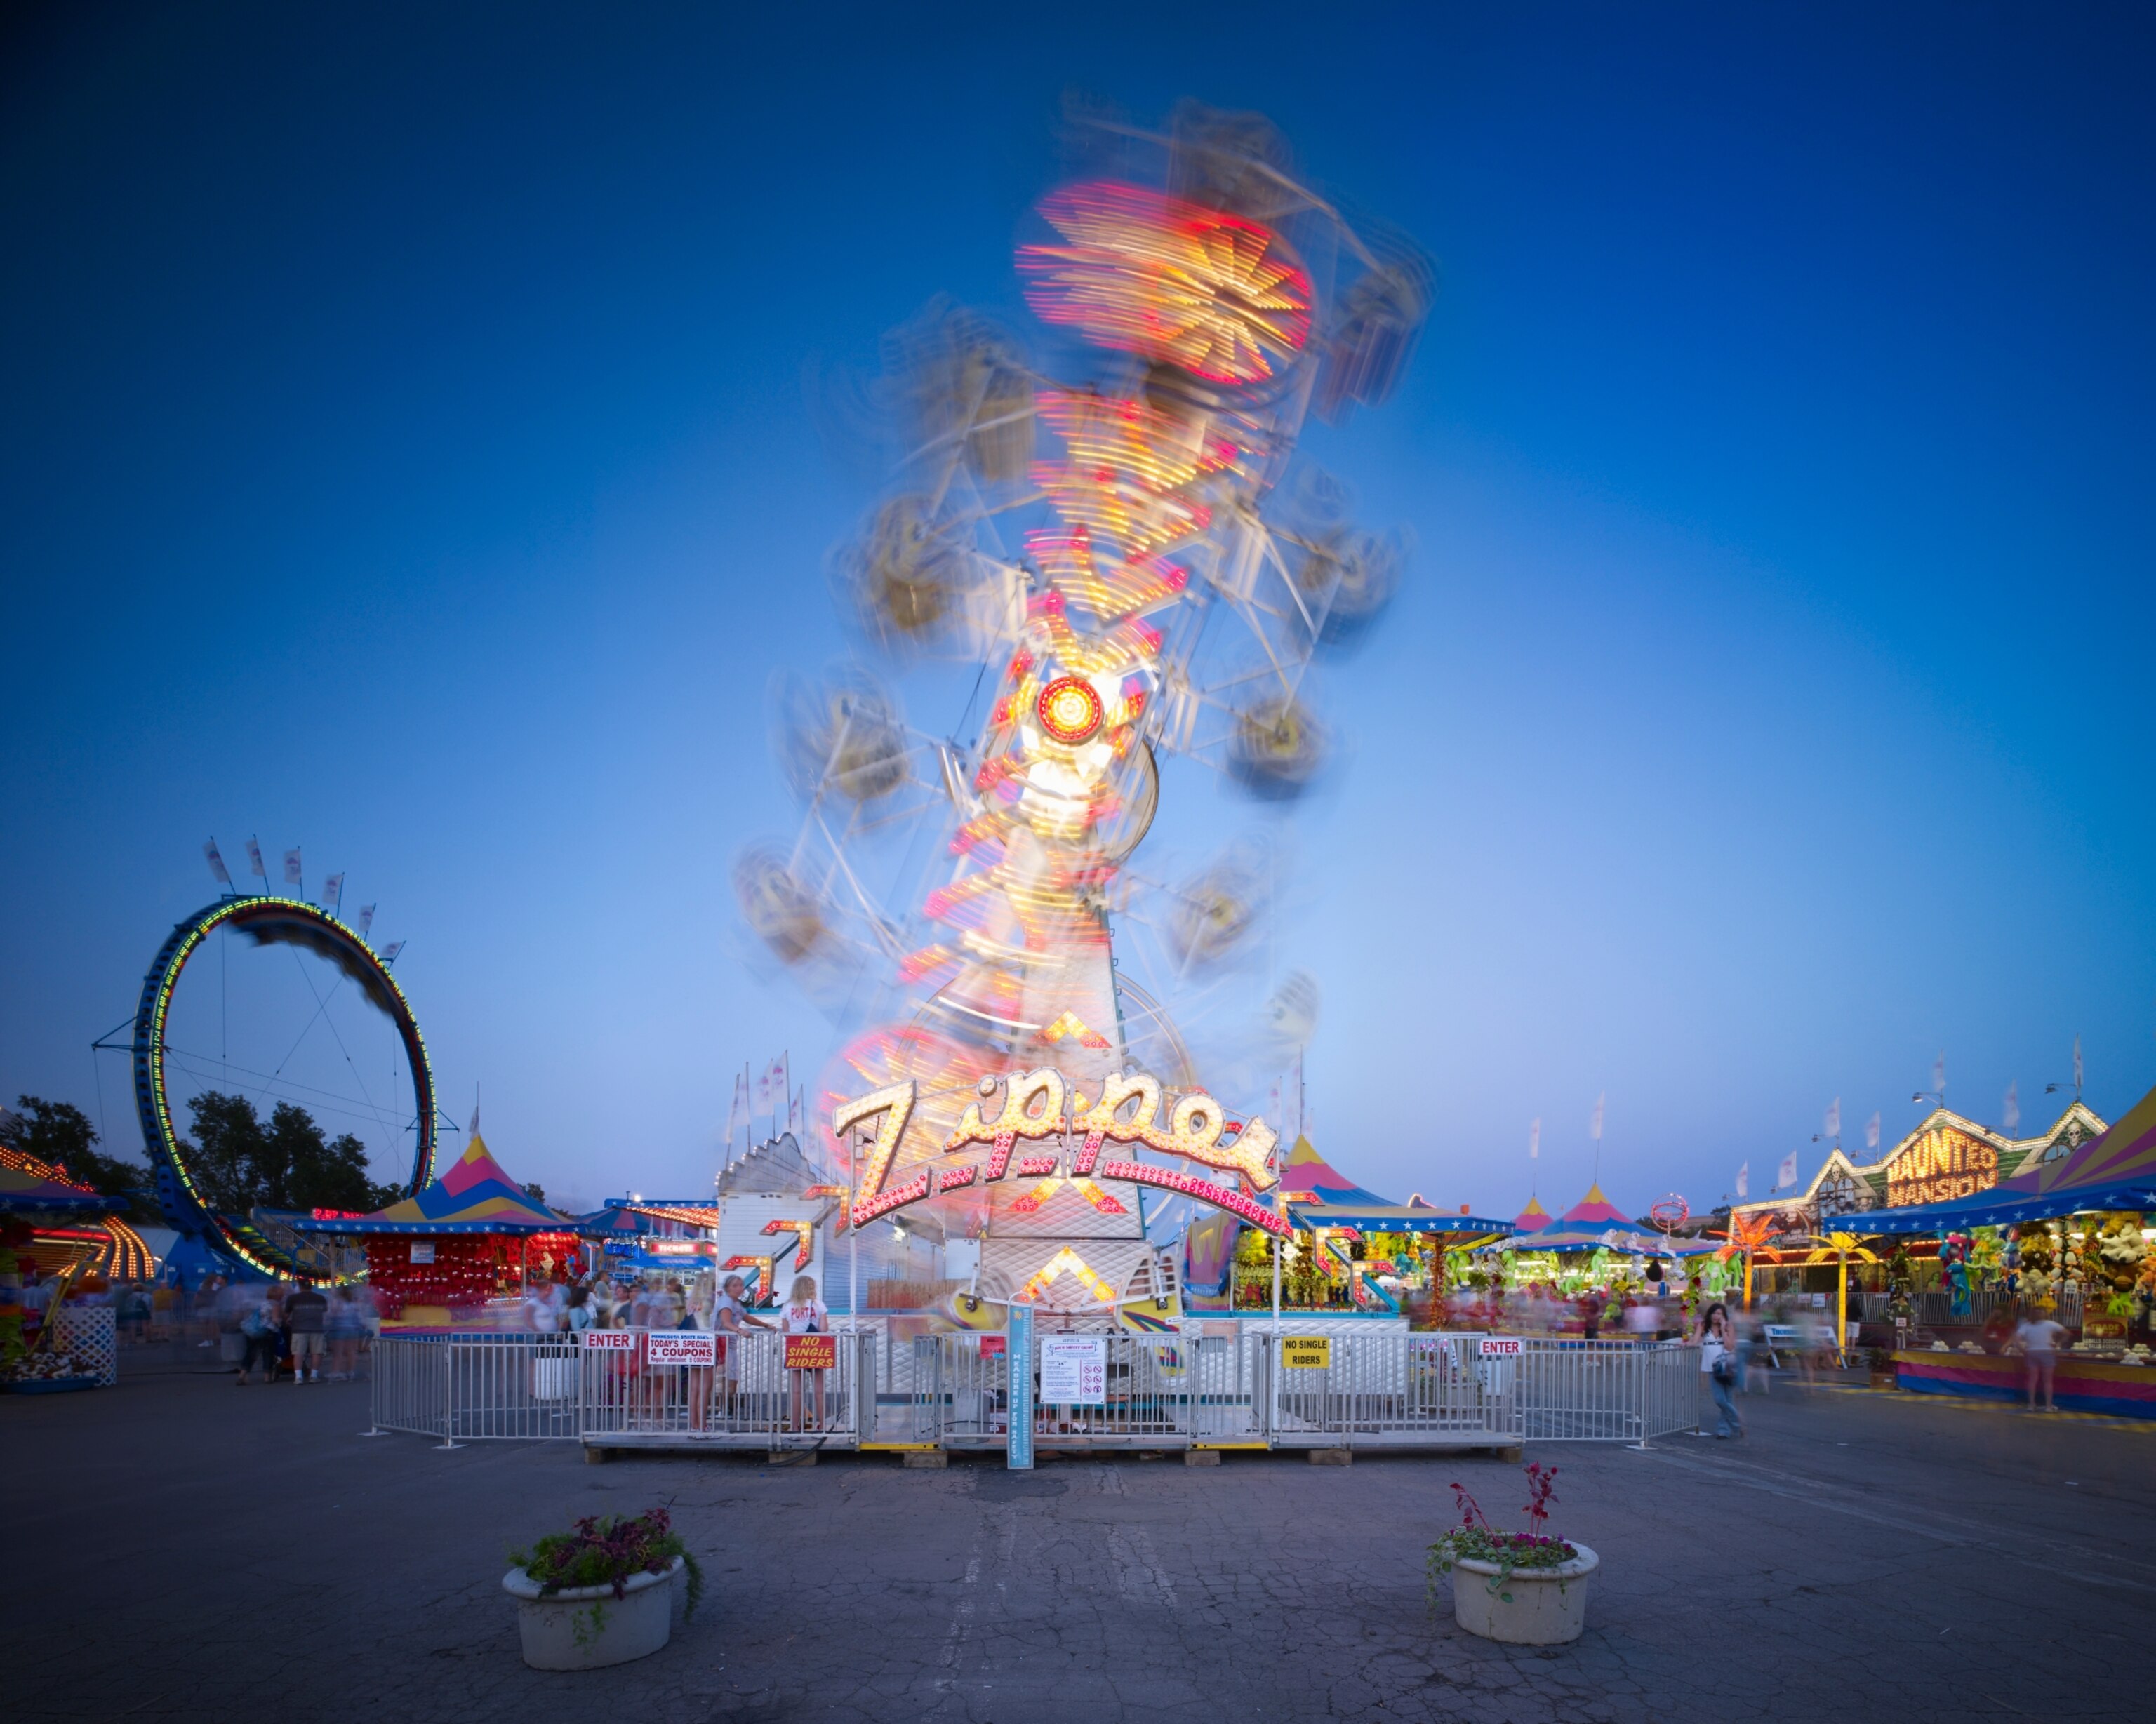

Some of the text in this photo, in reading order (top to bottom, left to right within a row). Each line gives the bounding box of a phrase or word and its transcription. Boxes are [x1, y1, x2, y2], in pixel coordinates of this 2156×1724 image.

[833, 1066, 1282, 1231] Zipper
[1886, 1126, 1999, 1184] HAUNTED
[1886, 1169, 1999, 1208] MANSION
[588, 1334, 630, 1347] ENTER
[650, 1339, 714, 1349] TODAY'S SPECIAL!
[800, 1337, 820, 1346] NO
[1286, 1340, 1327, 1349] NO SINGLE
[650, 1347, 713, 1357] 4 COUPONS
[787, 1347, 832, 1356] SINGLE
[1482, 1341, 1519, 1354] ENTER
[786, 1358, 834, 1367] RIDERS
[1292, 1356, 1321, 1365] RIDERS
[1012, 1354, 1021, 1396] MEASURE
[1012, 1398, 1019, 1409] UP
